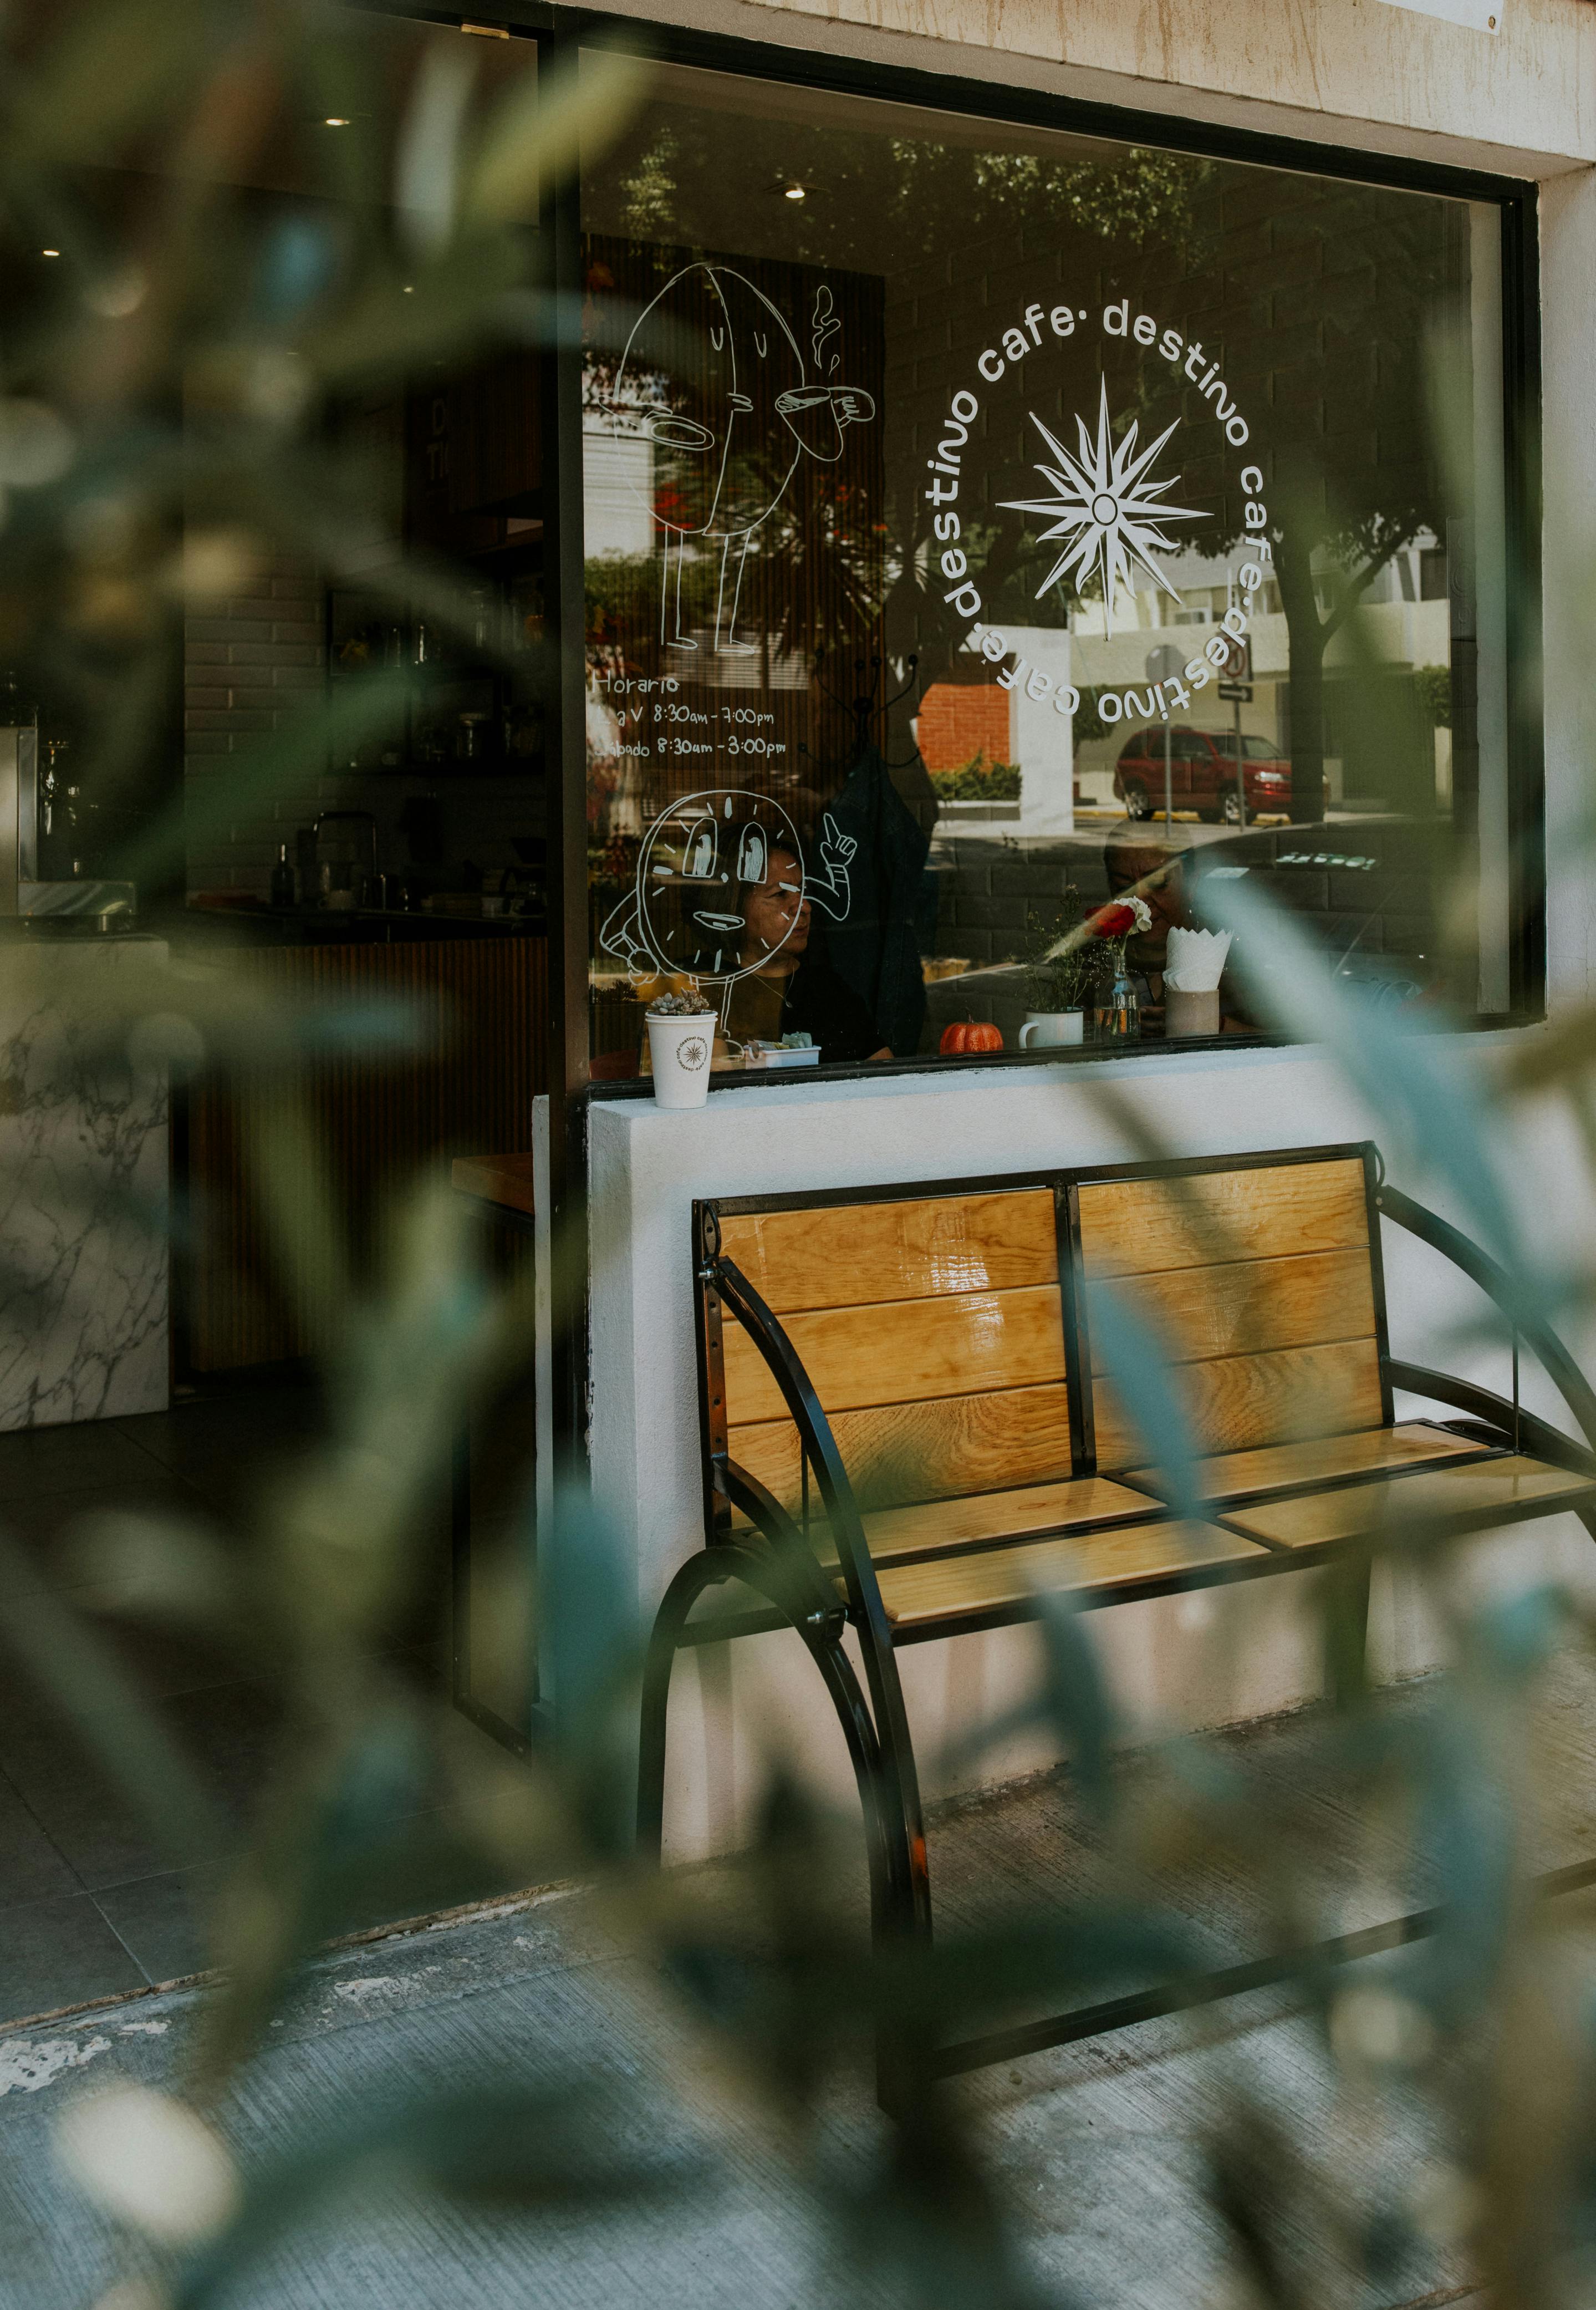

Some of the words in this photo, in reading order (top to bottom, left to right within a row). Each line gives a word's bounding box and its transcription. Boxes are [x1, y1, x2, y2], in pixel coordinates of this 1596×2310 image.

[1104, 299, 1249, 446] destino
[926, 390, 981, 617] destino
[592, 669, 680, 694] Horario
[630, 706, 644, 722] V
[1098, 608, 1247, 722] destino
